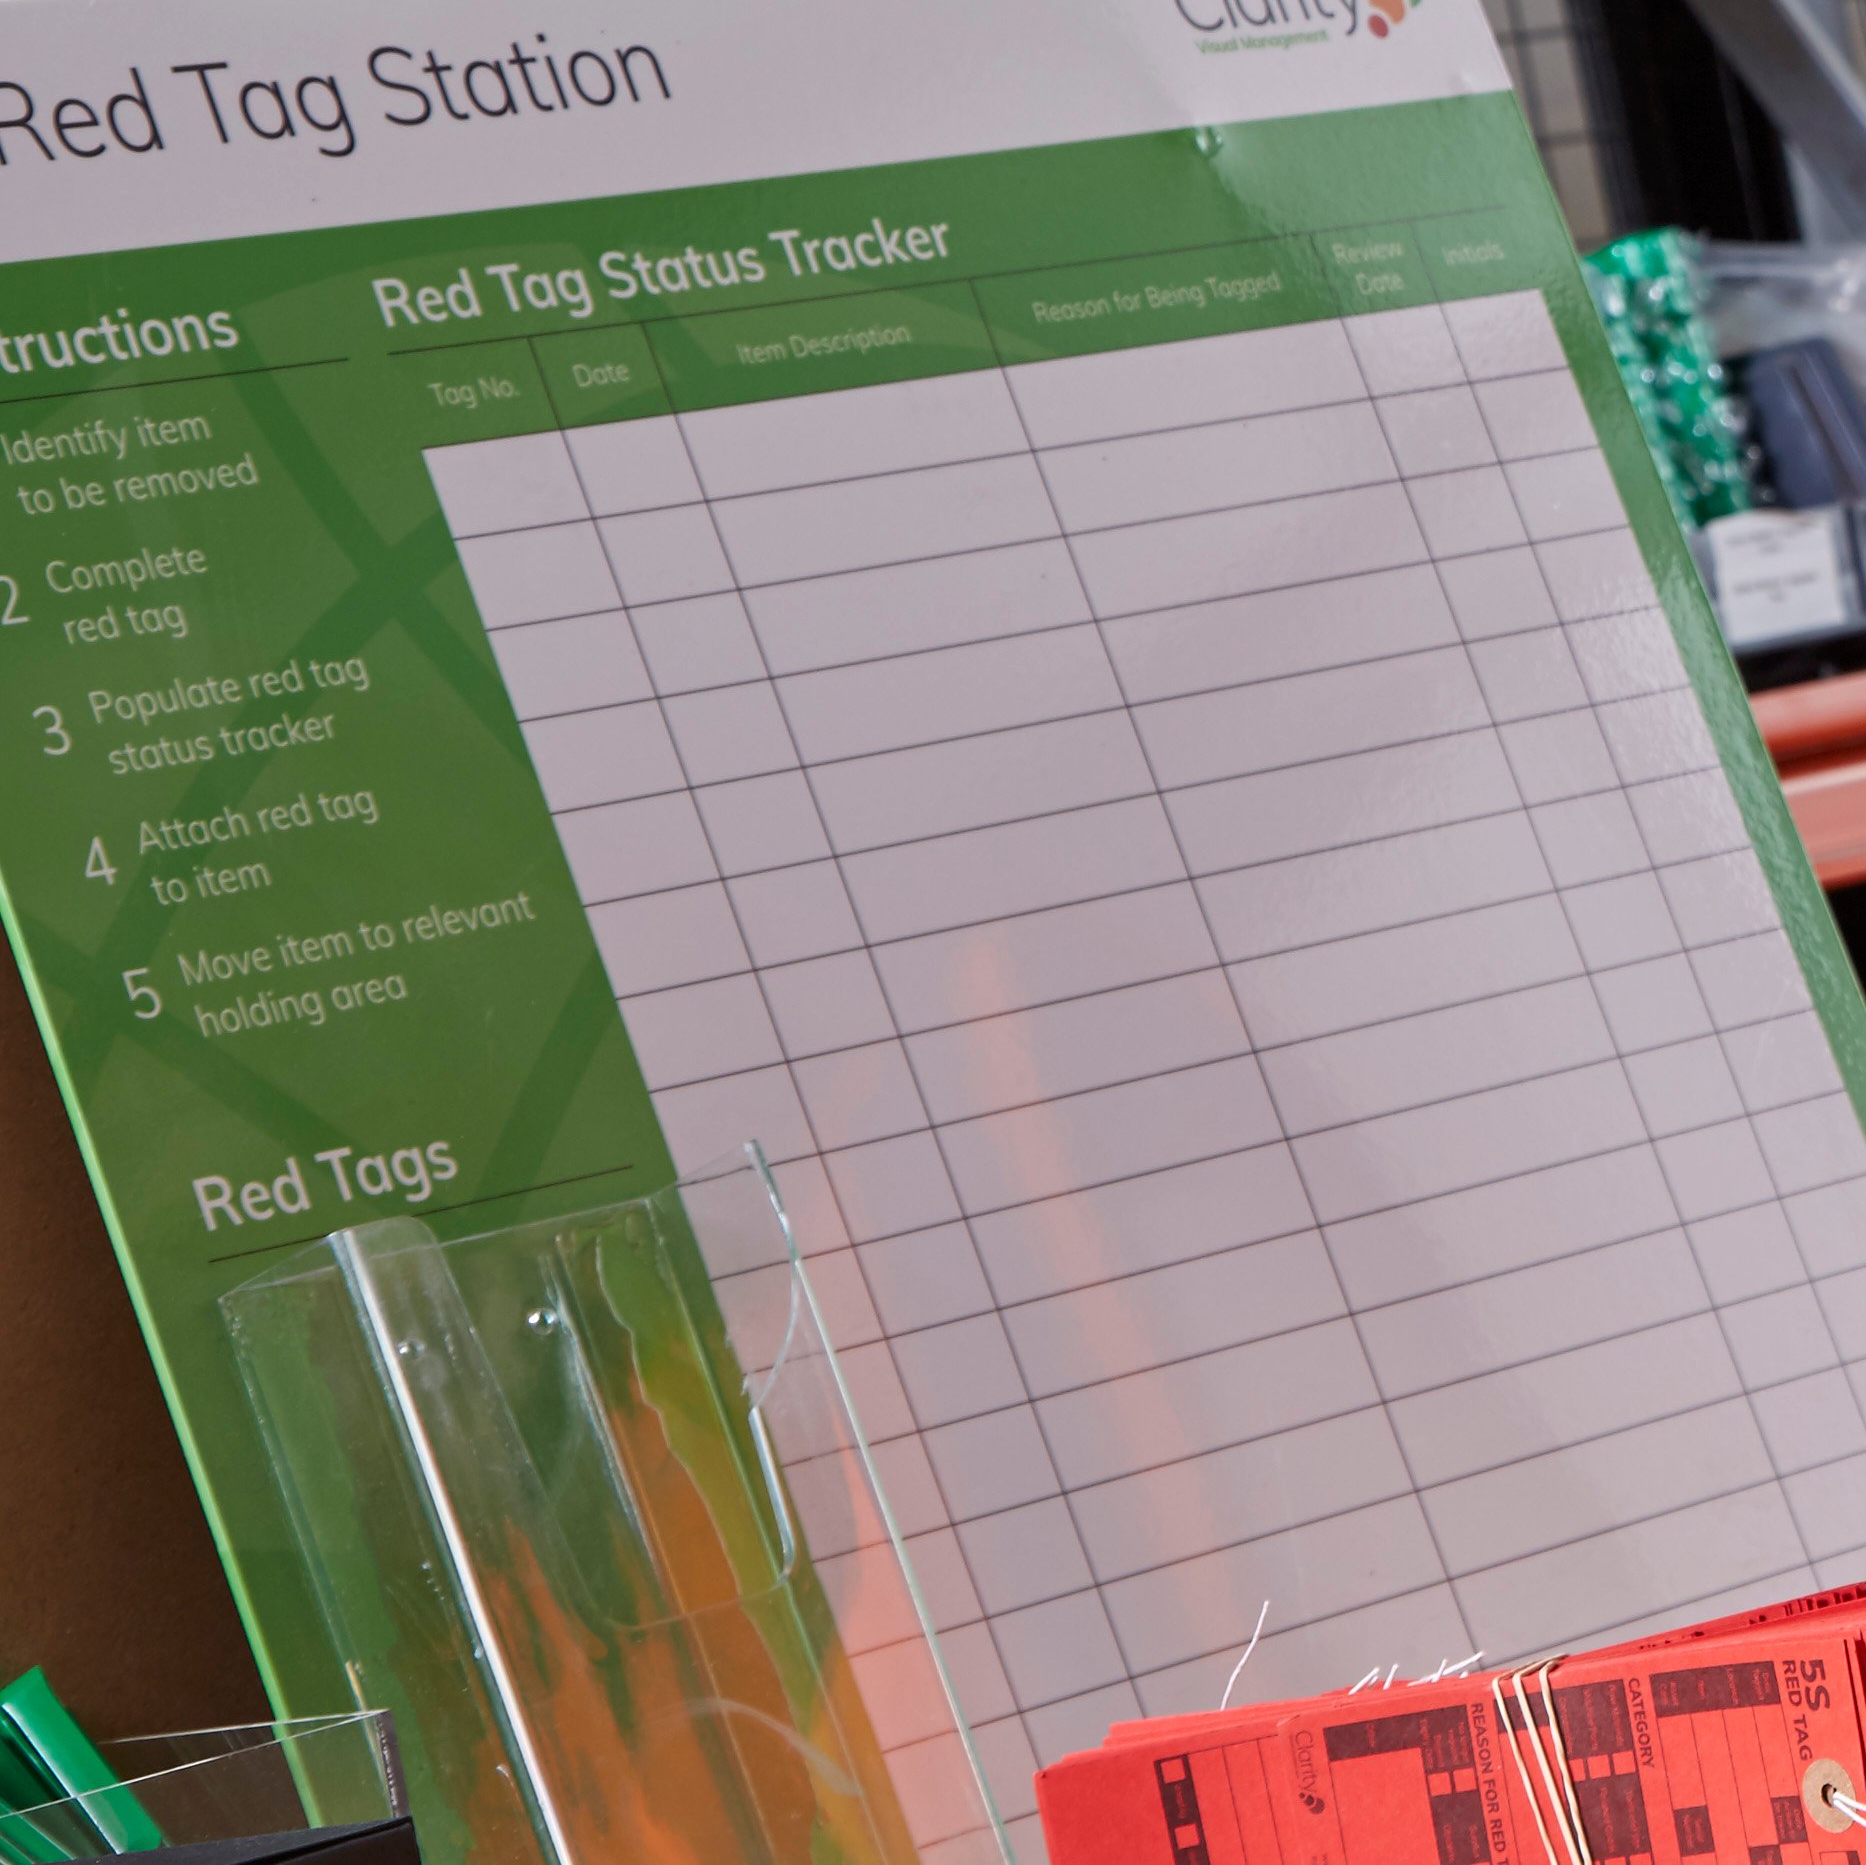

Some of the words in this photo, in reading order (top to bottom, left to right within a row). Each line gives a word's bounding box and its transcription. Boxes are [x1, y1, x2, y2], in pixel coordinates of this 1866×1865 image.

[0, 68, 164, 165] Red
[172, 62, 356, 158] Tag
[368, 34, 672, 126] Station
[372, 266, 481, 327] Red
[487, 264, 594, 318] Tag
[599, 242, 766, 300] Status
[768, 217, 948, 276] Tracker
[1332, 241, 1403, 265] Review
[1356, 272, 1403, 295] Date
[1443, 240, 1505, 265] Initials
[1032, 295, 1109, 324] Reason
[1112, 290, 1142, 313] for
[1144, 281, 1206, 308] Being
[1206, 272, 1280, 301] Tagged
[572, 361, 629, 388] Date
[736, 342, 787, 364] Item
[789, 324, 912, 356] Description
[429, 381, 475, 408] Tag
[479, 376, 520, 401] No.
[2, 421, 128, 465] Identify
[136, 413, 213, 447] item
[18, 484, 54, 515] to
[66, 475, 104, 510] be
[115, 453, 260, 503] removed
[0, 574, 30, 625] 2
[46, 545, 208, 593] Complete
[63, 606, 119, 645] red
[126, 601, 188, 638] tag
[32, 705, 72, 756] 3
[88, 676, 241, 725] Populate
[249, 662, 304, 702] red
[308, 655, 371, 691] tag
[108, 730, 213, 775] status
[220, 710, 335, 756] tracker
[84, 836, 117, 885] 4
[137, 807, 252, 854] Attach
[257, 794, 312, 832] red
[317, 787, 379, 824] tag
[150, 874, 187, 906] to
[195, 859, 271, 897] item
[121, 967, 162, 1019] 5
[178, 942, 272, 987] Move
[278, 929, 354, 967] item
[358, 917, 395, 951] to
[402, 892, 535, 944] relevant
[194, 989, 326, 1037] holding
[331, 972, 407, 1011] area
[192, 1157, 311, 1231] Red
[315, 1140, 458, 1203] Tags
[1782, 1660, 1803, 1707] RED
[1793, 1714, 1813, 1761] TAG
[1800, 1659, 1831, 1712] 5S
[1471, 1702, 1493, 1775] REASON
[1628, 1677, 1655, 1768] CATEGORY
[1294, 1731, 1318, 1794] Clarity
[1483, 1779, 1500, 1814] FOR
[1490, 1819, 1506, 1853] RED
